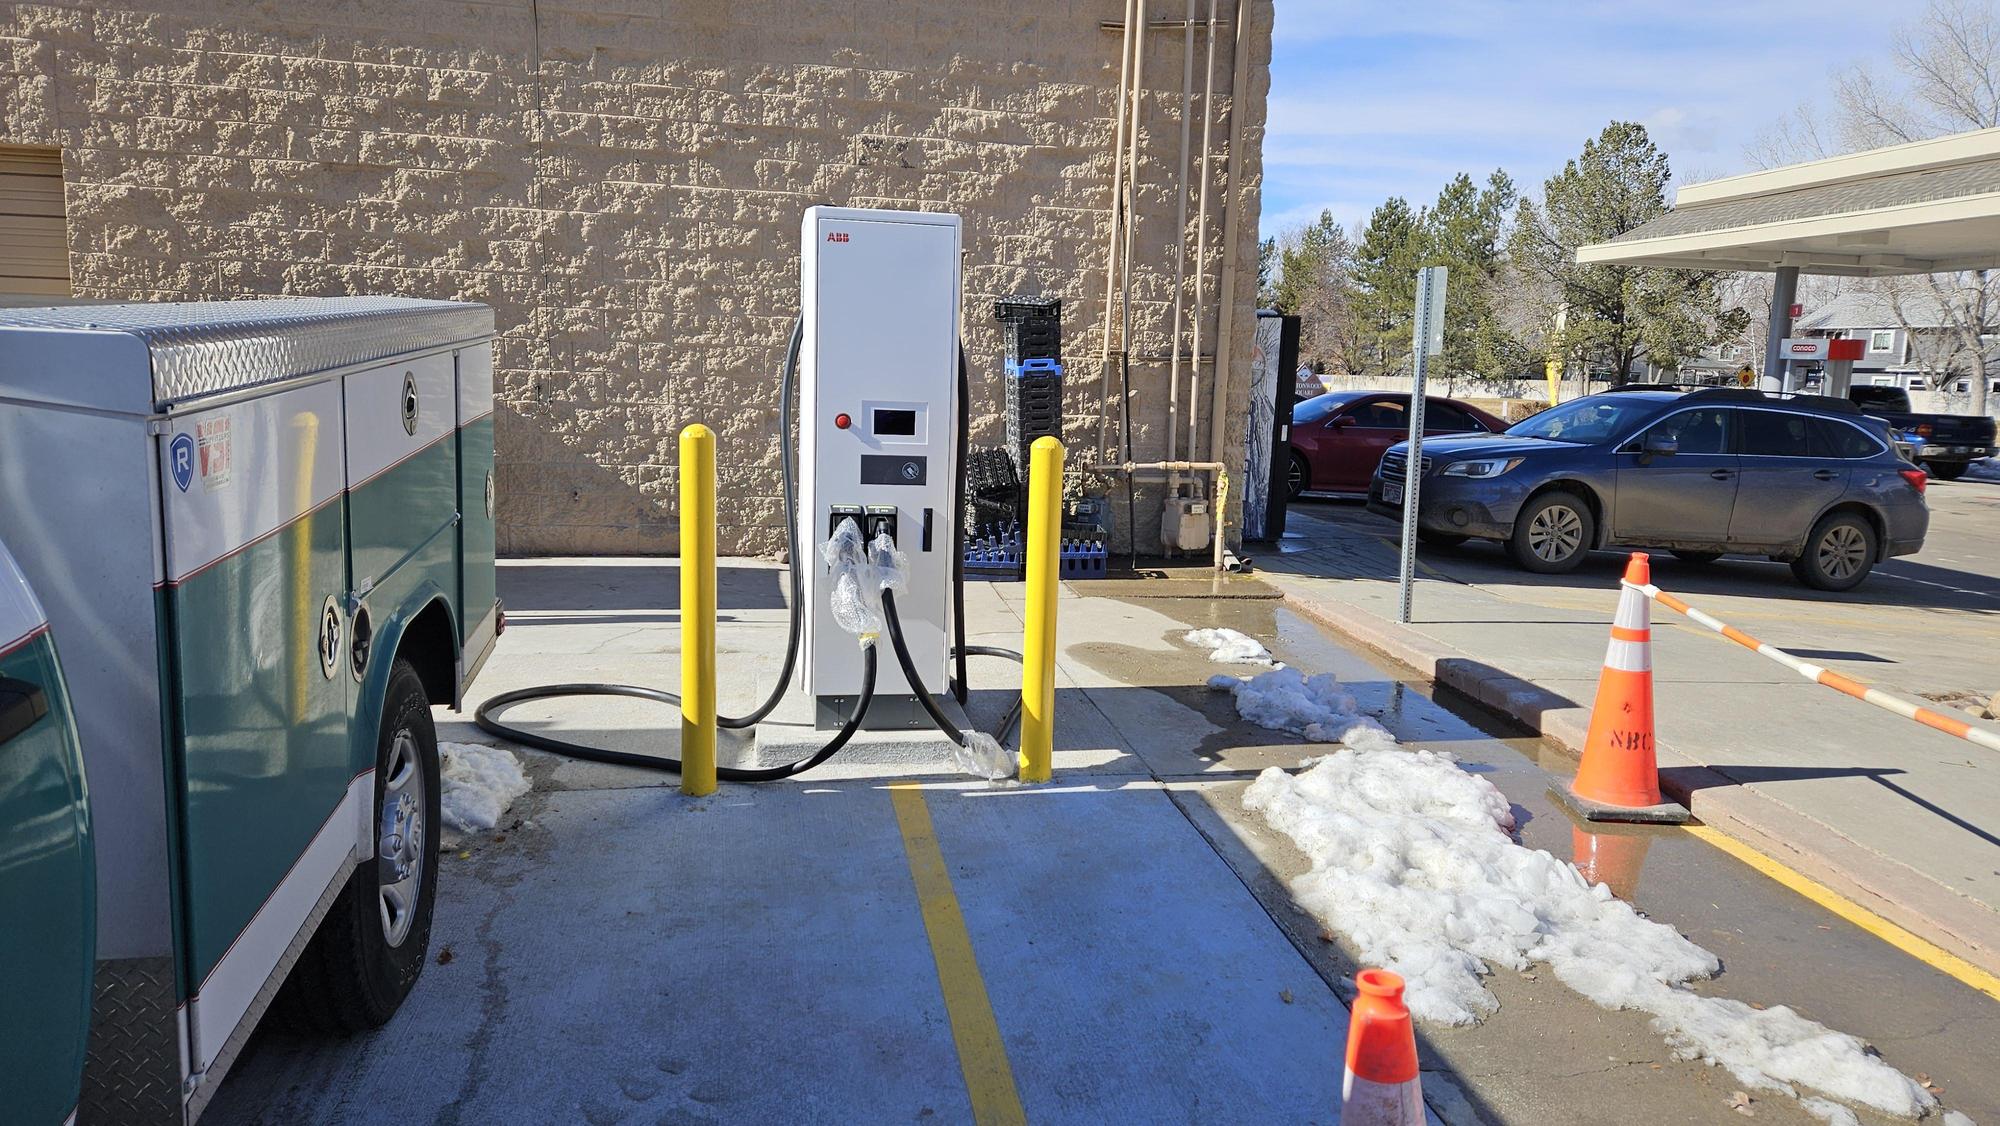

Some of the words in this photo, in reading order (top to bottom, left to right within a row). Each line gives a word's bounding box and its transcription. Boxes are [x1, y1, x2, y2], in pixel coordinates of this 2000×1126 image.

[827, 232, 850, 242] ABB
[177, 447, 189, 473] R
[1611, 730, 1652, 751] NBC
